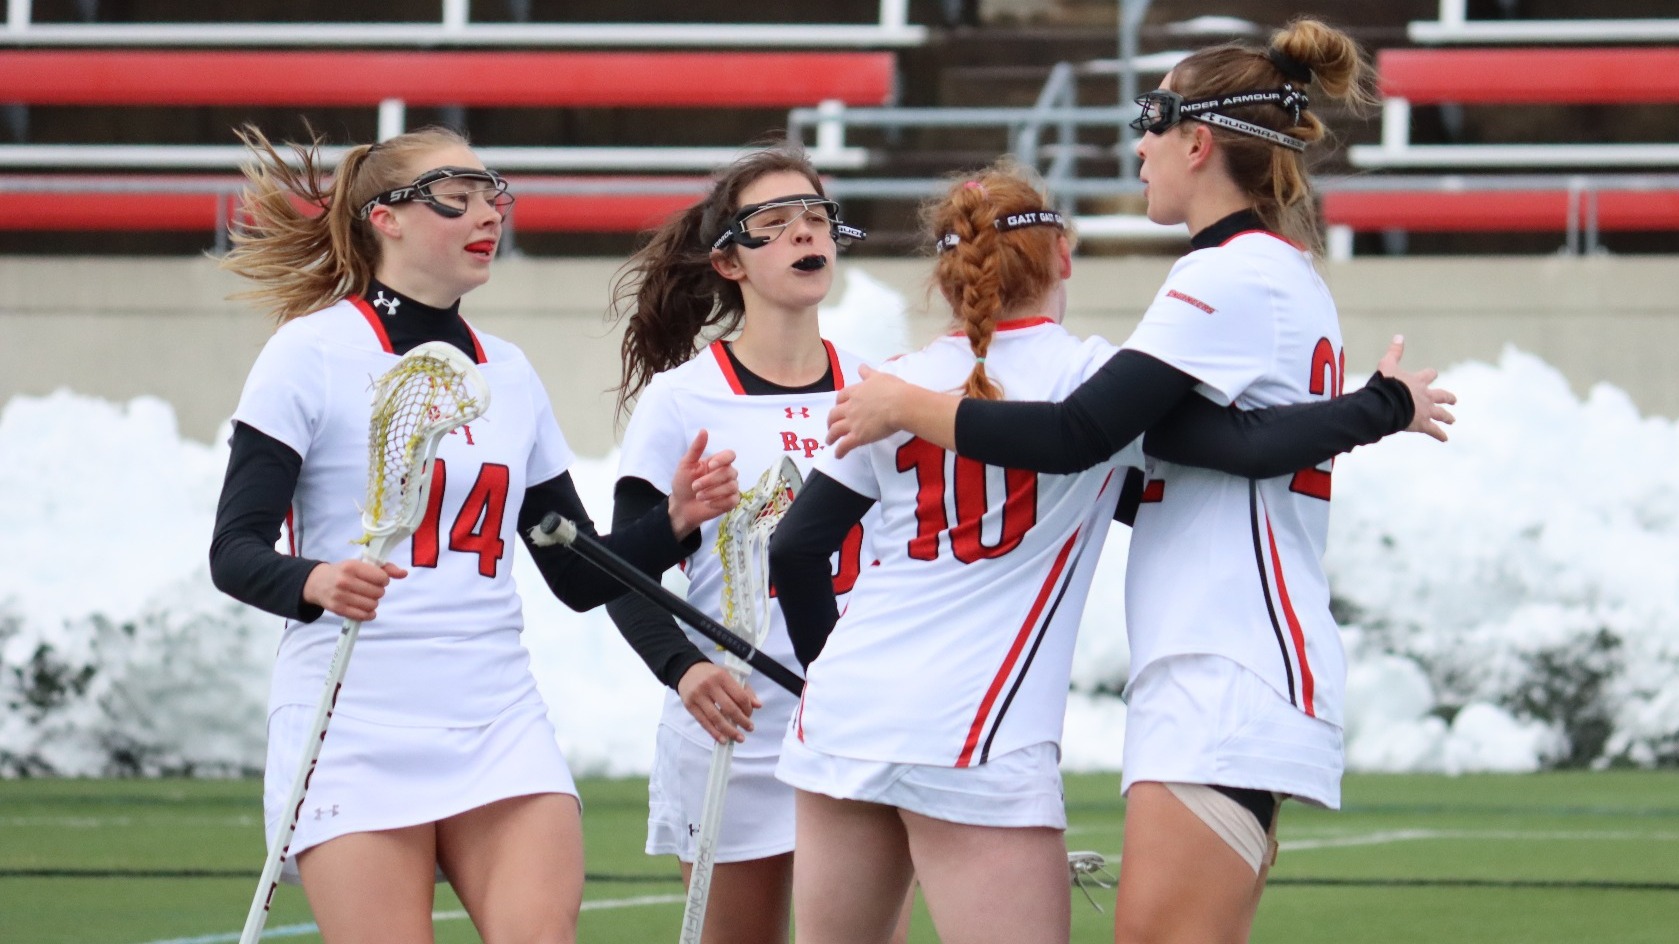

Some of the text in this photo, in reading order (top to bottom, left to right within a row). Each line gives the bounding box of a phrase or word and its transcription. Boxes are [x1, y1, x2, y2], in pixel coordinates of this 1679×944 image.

[1180, 92, 1280, 112] NDER ARMOUR
[390, 187, 415, 202] ST
[1007, 212, 1036, 226] GAIT
[780, 431, 824, 458] RP
[896, 435, 1038, 564] 10
[410, 458, 510, 578] 14
